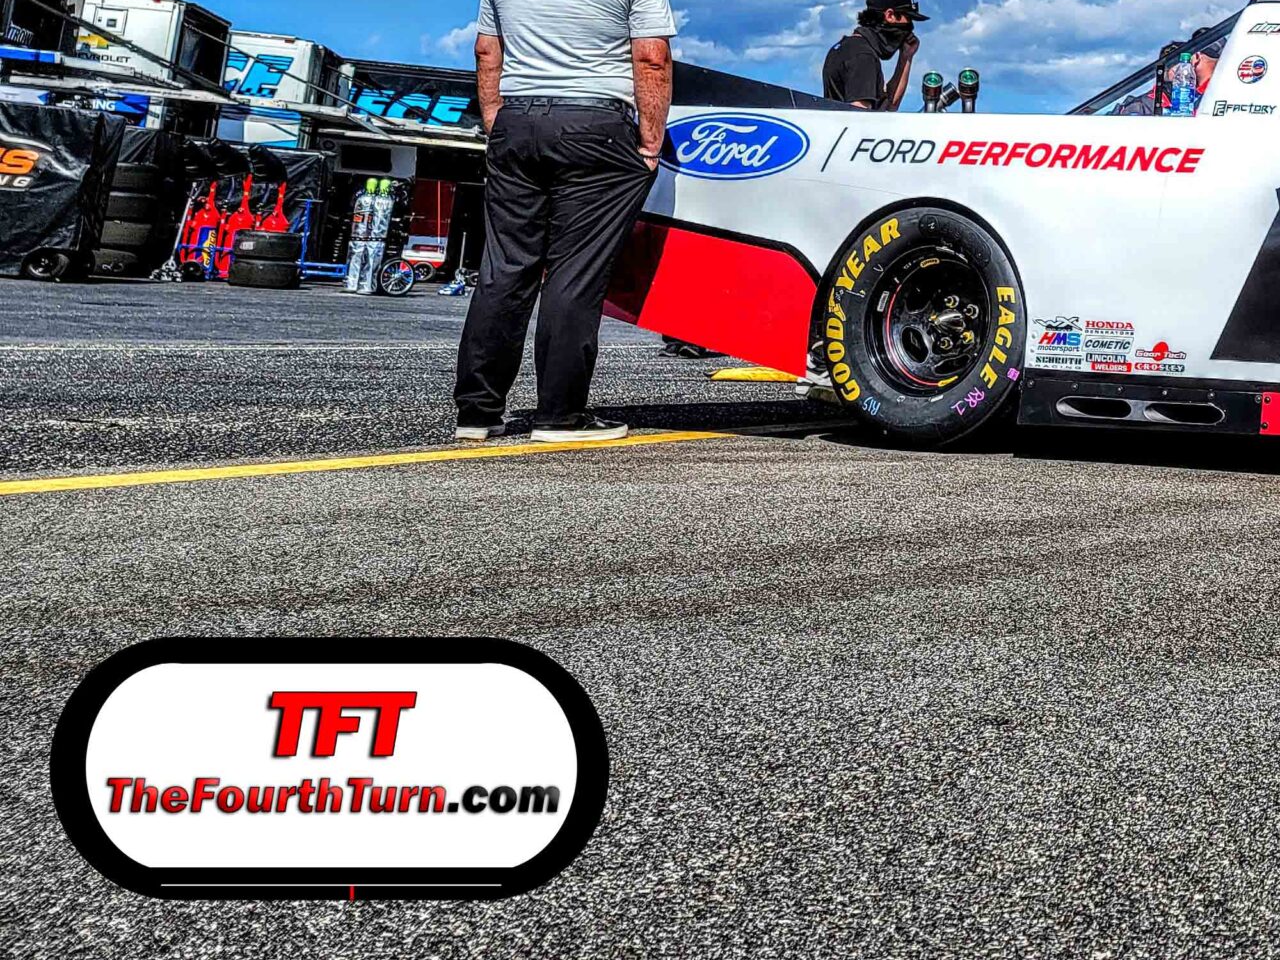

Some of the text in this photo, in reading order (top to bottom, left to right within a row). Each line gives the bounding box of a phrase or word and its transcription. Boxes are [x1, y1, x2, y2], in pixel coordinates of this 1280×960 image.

[1226, 103, 1277, 114] FACTORY
[676, 122, 770, 168] Ford
[850, 138, 1205, 174] FORD PERFORMANCE
[826, 217, 901, 401] GOODYEAR
[1085, 320, 1134, 330] HONDA
[979, 286, 1016, 389] EAGLE
[1039, 331, 1081, 346] HMS
[1037, 345, 1080, 353] motorsport
[1084, 339, 1131, 350] COMETIC
[1087, 353, 1126, 363] LINCOLN
[1136, 350, 1187, 359] Gear Tech
[1094, 363, 1128, 372] WELDERS
[1135, 363, 1185, 372] CROSLEY
